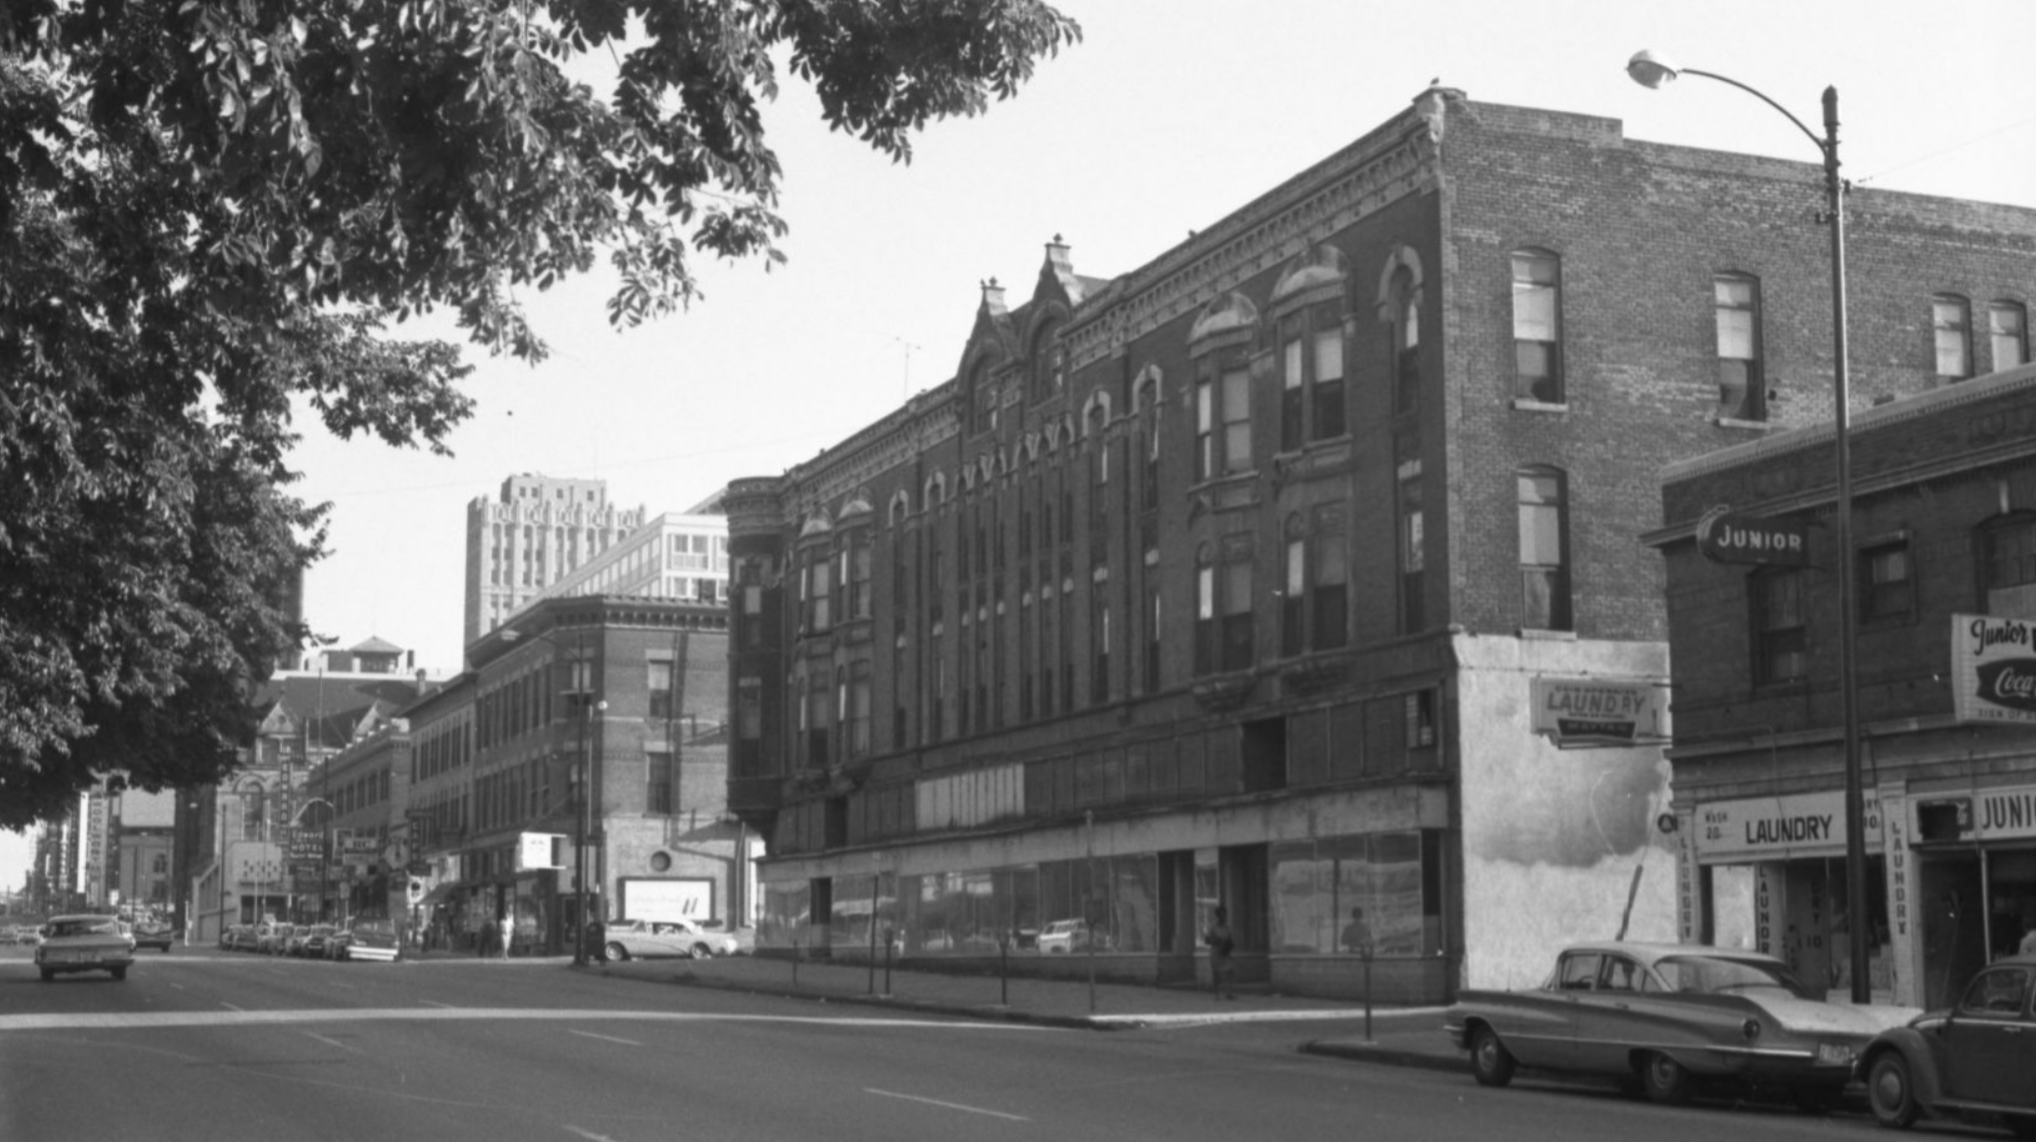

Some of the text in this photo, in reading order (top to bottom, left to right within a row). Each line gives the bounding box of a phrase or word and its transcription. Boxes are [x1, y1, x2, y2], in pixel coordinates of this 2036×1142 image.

[1717, 525, 1803, 551] JUNIOR
[1971, 619, 2027, 656] Junior
[1547, 691, 1646, 715] LAUNDRY
[1745, 814, 1833, 844] LAUNDRY
[1982, 794, 2036, 830] JUNI
[1681, 838, 1692, 939] LAUNDRY
[1893, 821, 1907, 936] LAUNDRY
[1759, 865, 1770, 954] LAUNDR
